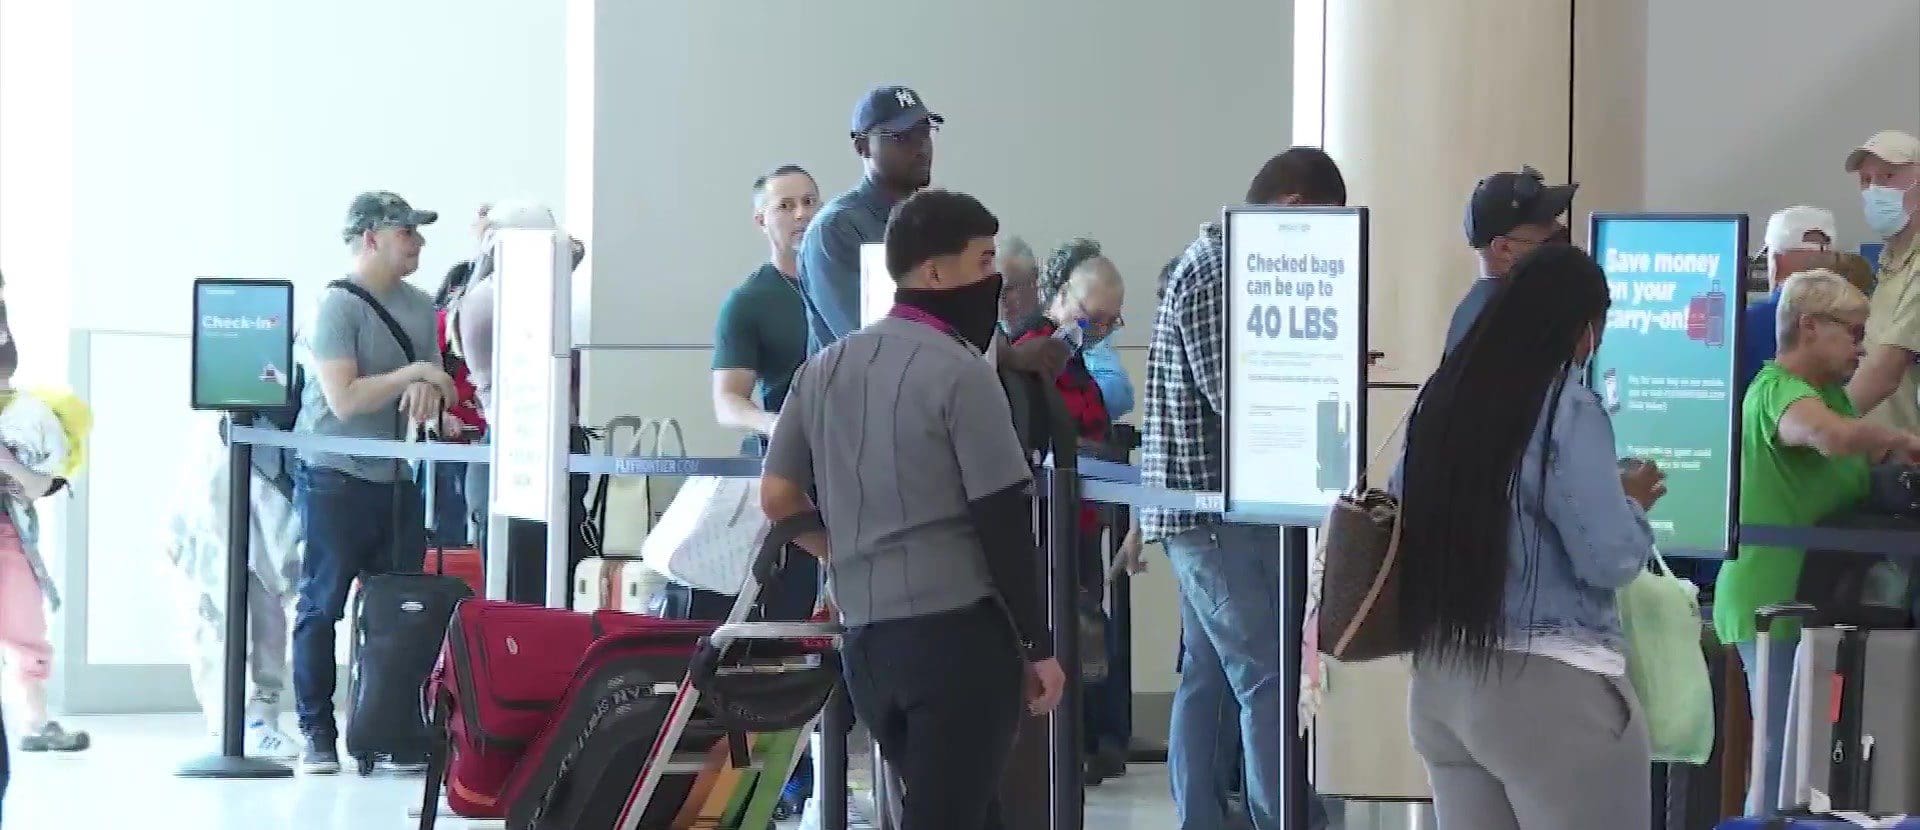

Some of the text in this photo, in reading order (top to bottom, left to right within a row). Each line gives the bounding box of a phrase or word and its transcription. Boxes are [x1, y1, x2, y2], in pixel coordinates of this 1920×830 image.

[1247, 254, 1345, 278] Checked bags
[1605, 249, 1720, 278] Save money
[1247, 276, 1333, 300] can be up to
[1632, 281, 1676, 305] your
[1247, 304, 1338, 340] 40 LBS
